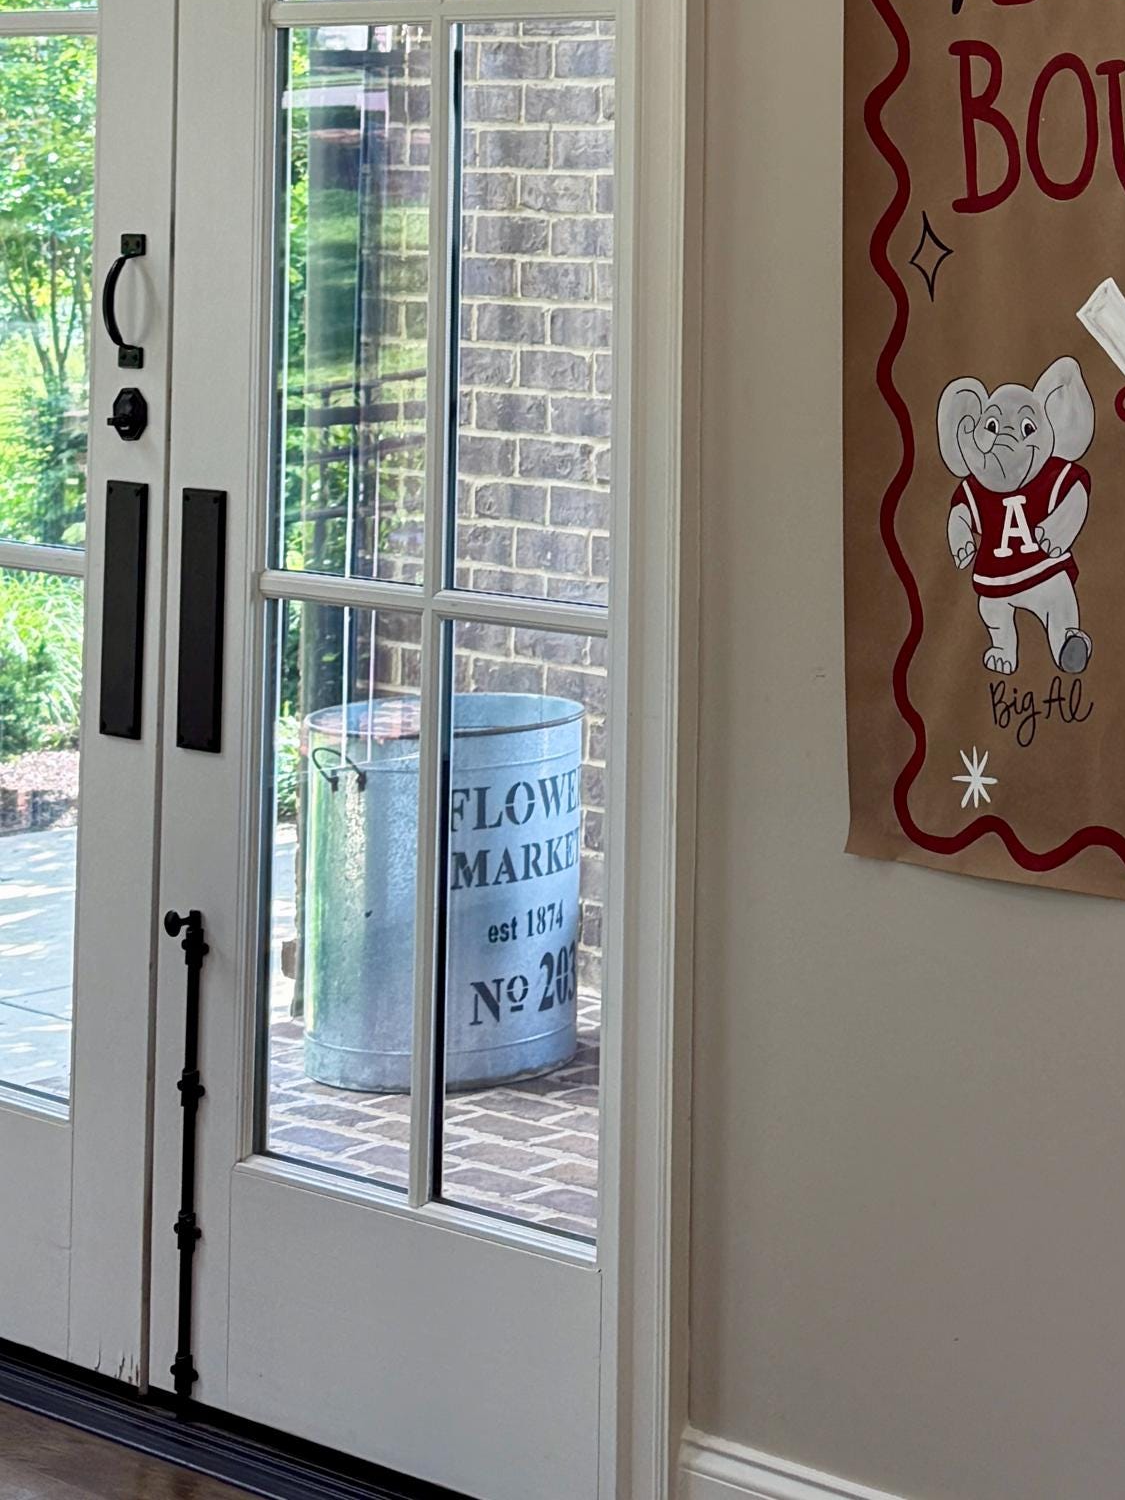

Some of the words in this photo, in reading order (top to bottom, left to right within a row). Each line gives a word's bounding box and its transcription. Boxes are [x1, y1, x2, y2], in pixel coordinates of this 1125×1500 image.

[993, 495, 1039, 558] A
[990, 680, 1041, 748] Big
[1042, 676, 1094, 723] Al
[450, 766, 580, 832] FLOWE
[487, 918, 518, 944] est
[526, 899, 564, 939] 1874
